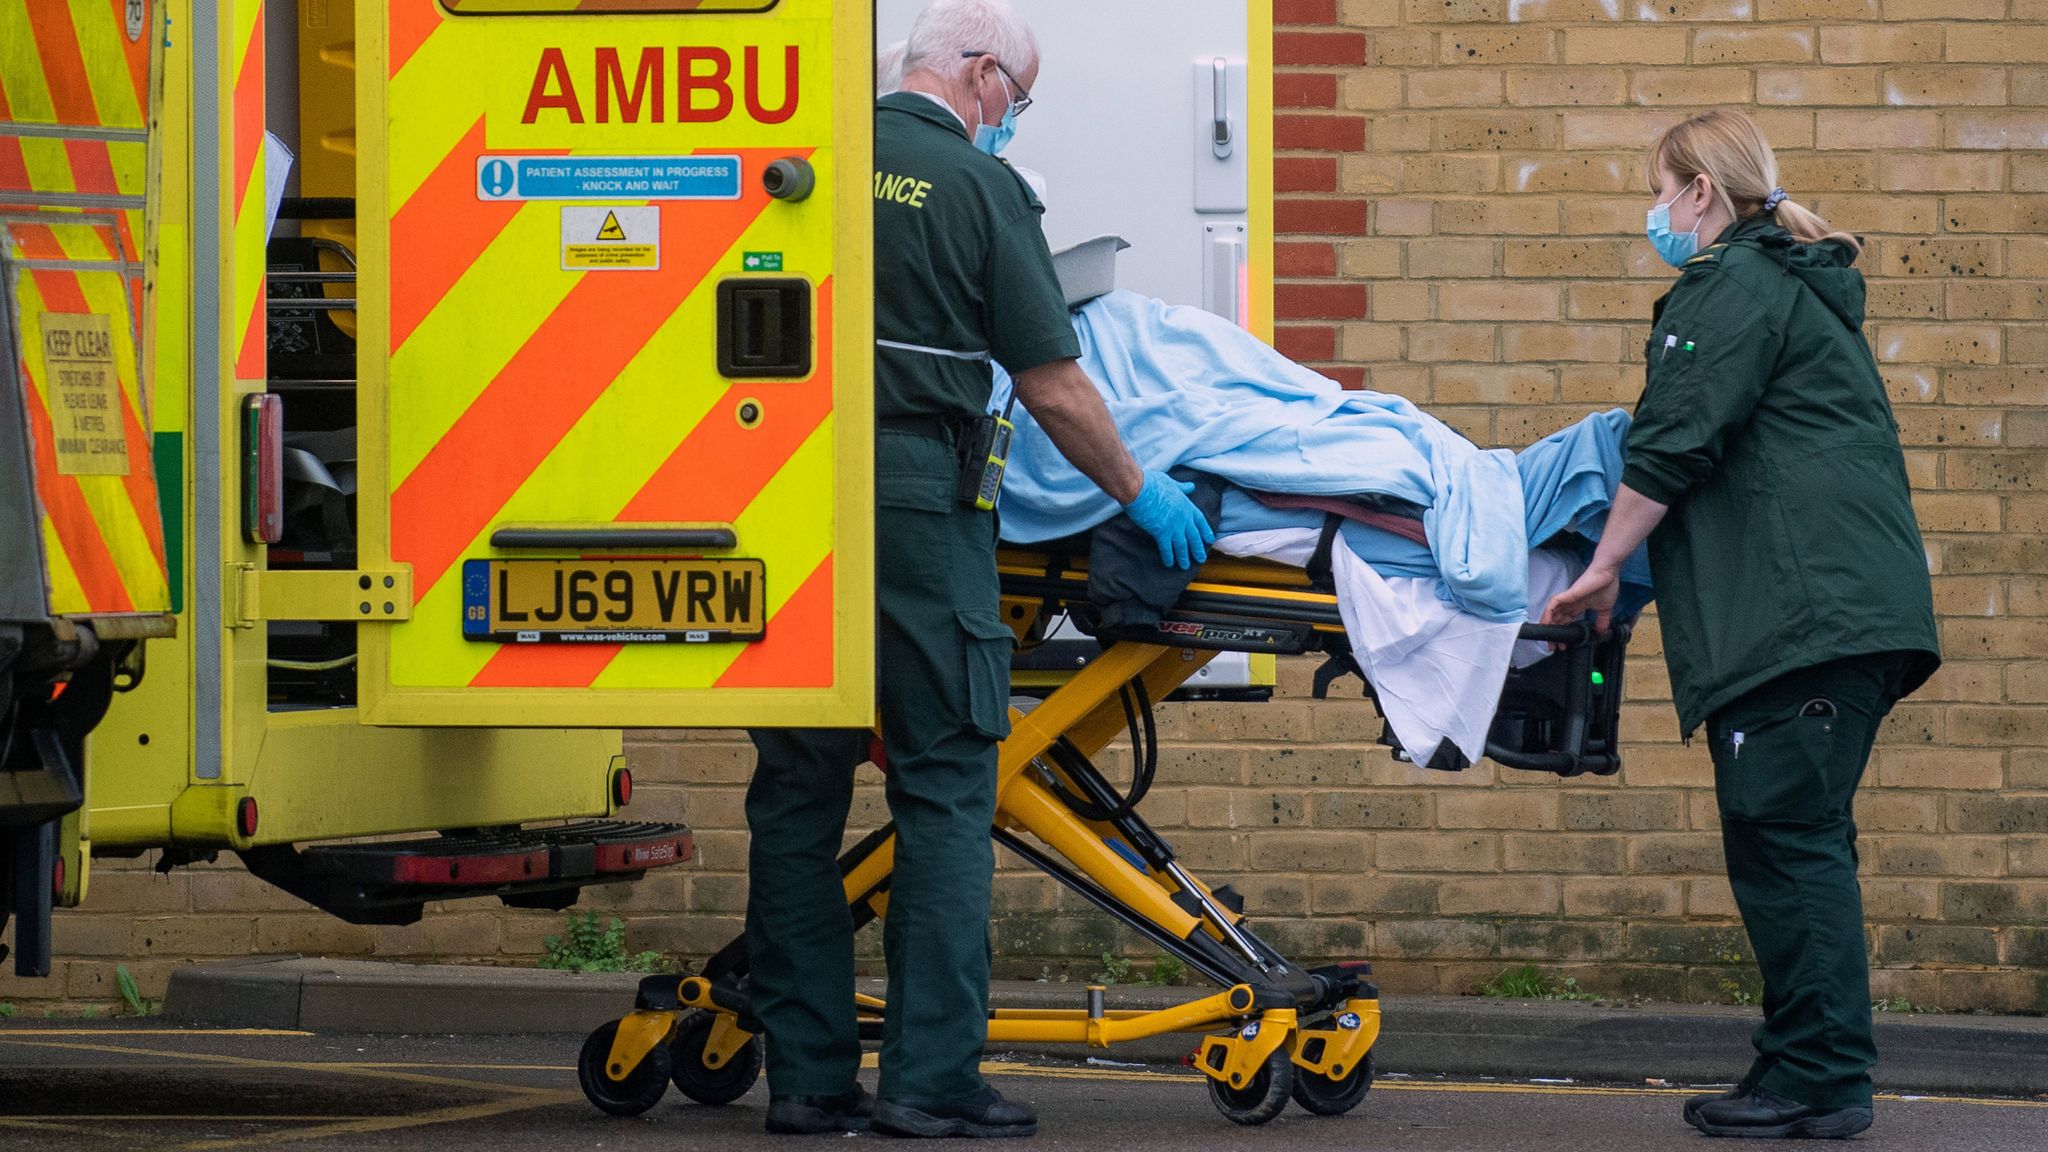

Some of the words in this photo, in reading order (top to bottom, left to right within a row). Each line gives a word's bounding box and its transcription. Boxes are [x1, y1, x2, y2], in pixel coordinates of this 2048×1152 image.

[521, 45, 799, 124] AMBU
[526, 166, 571, 178] PATIENT
[574, 166, 650, 178] ASSESSMENT
[652, 166, 664, 177] IN
[666, 165, 729, 177] PROGRESS
[582, 180, 622, 191] KNOCK
[624, 180, 649, 191] AND
[652, 180, 680, 191] WAIT
[45, 328, 71, 356] KEEP
[75, 329, 112, 357] CLEAR
[499, 569, 634, 622] LJ69
[652, 569, 753, 623] VRW
[468, 605, 486, 620] GB
[560, 632, 666, 642] www.was-vehicles.com
